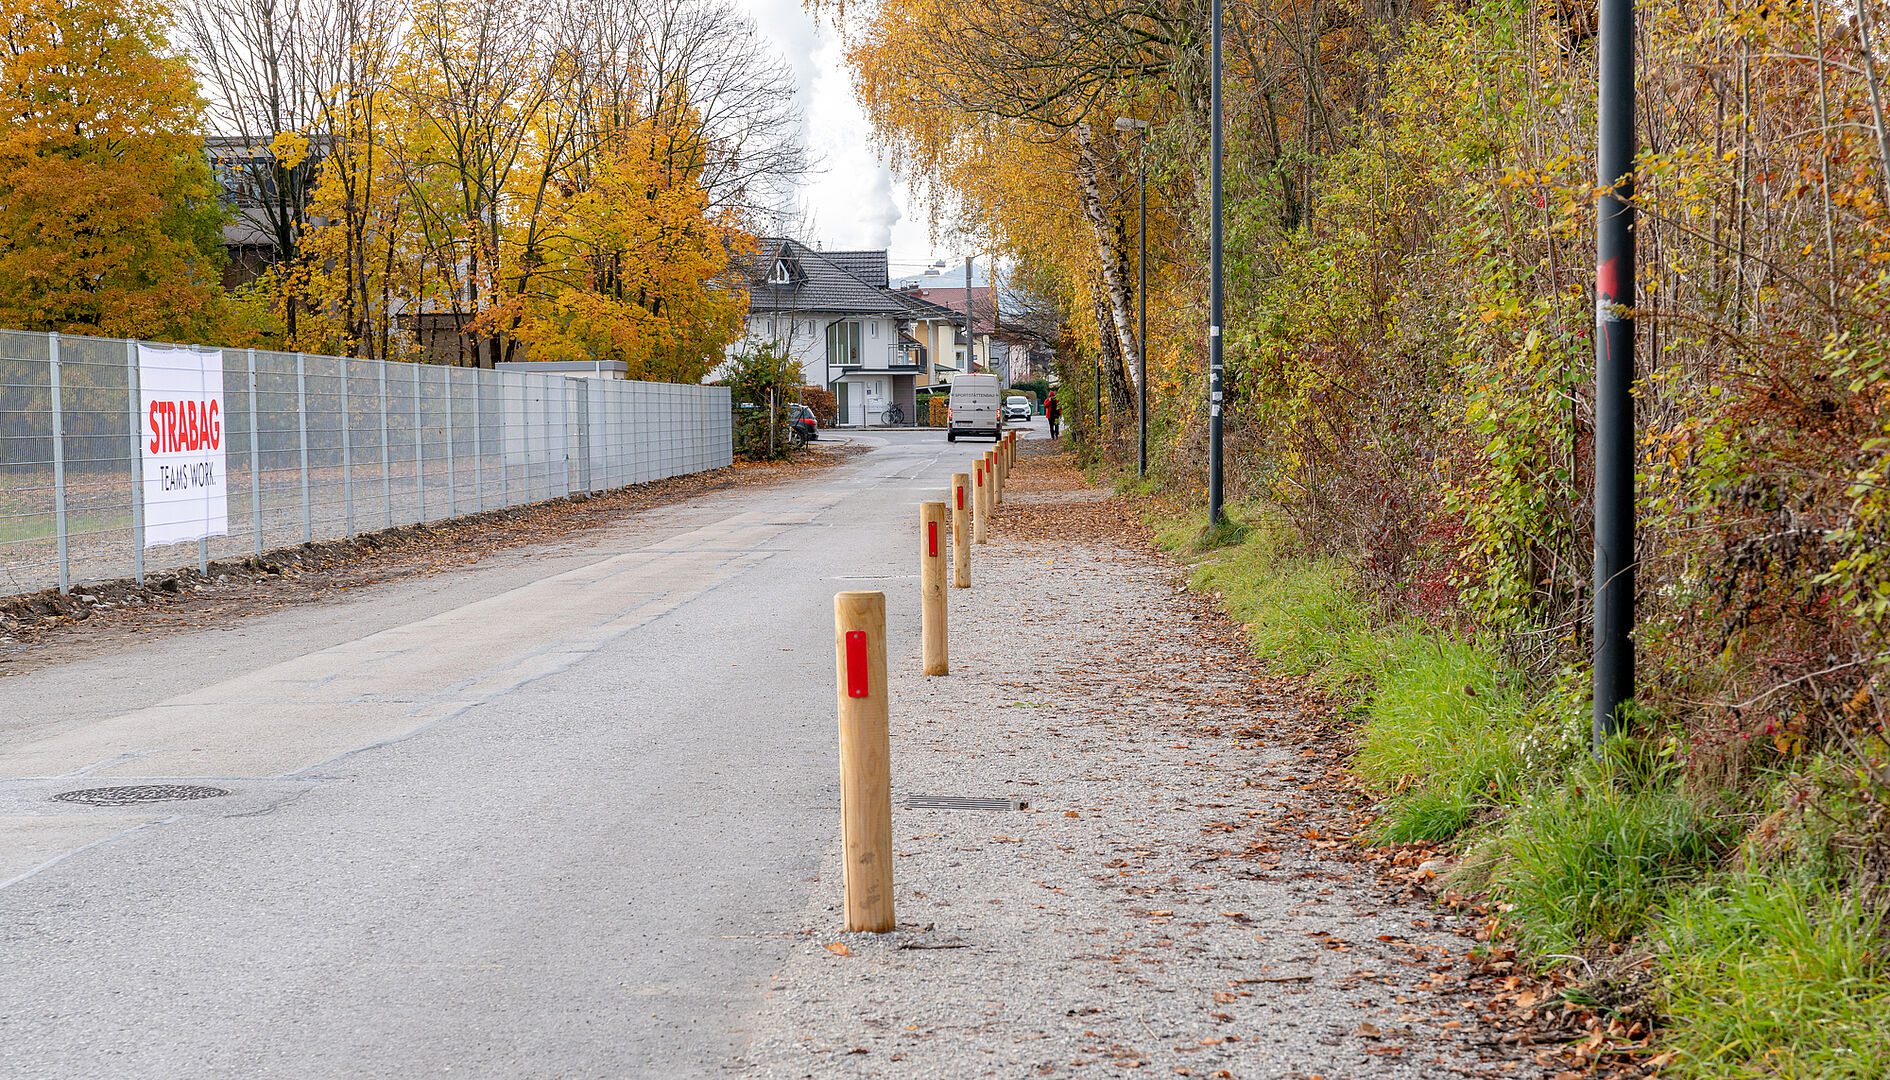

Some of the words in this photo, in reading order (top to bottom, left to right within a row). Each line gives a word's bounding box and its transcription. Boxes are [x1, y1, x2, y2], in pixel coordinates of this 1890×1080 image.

[149, 399, 220, 455] STRABAG
[160, 464, 188, 491] TEAMS
[189, 461, 217, 487] WORK.
